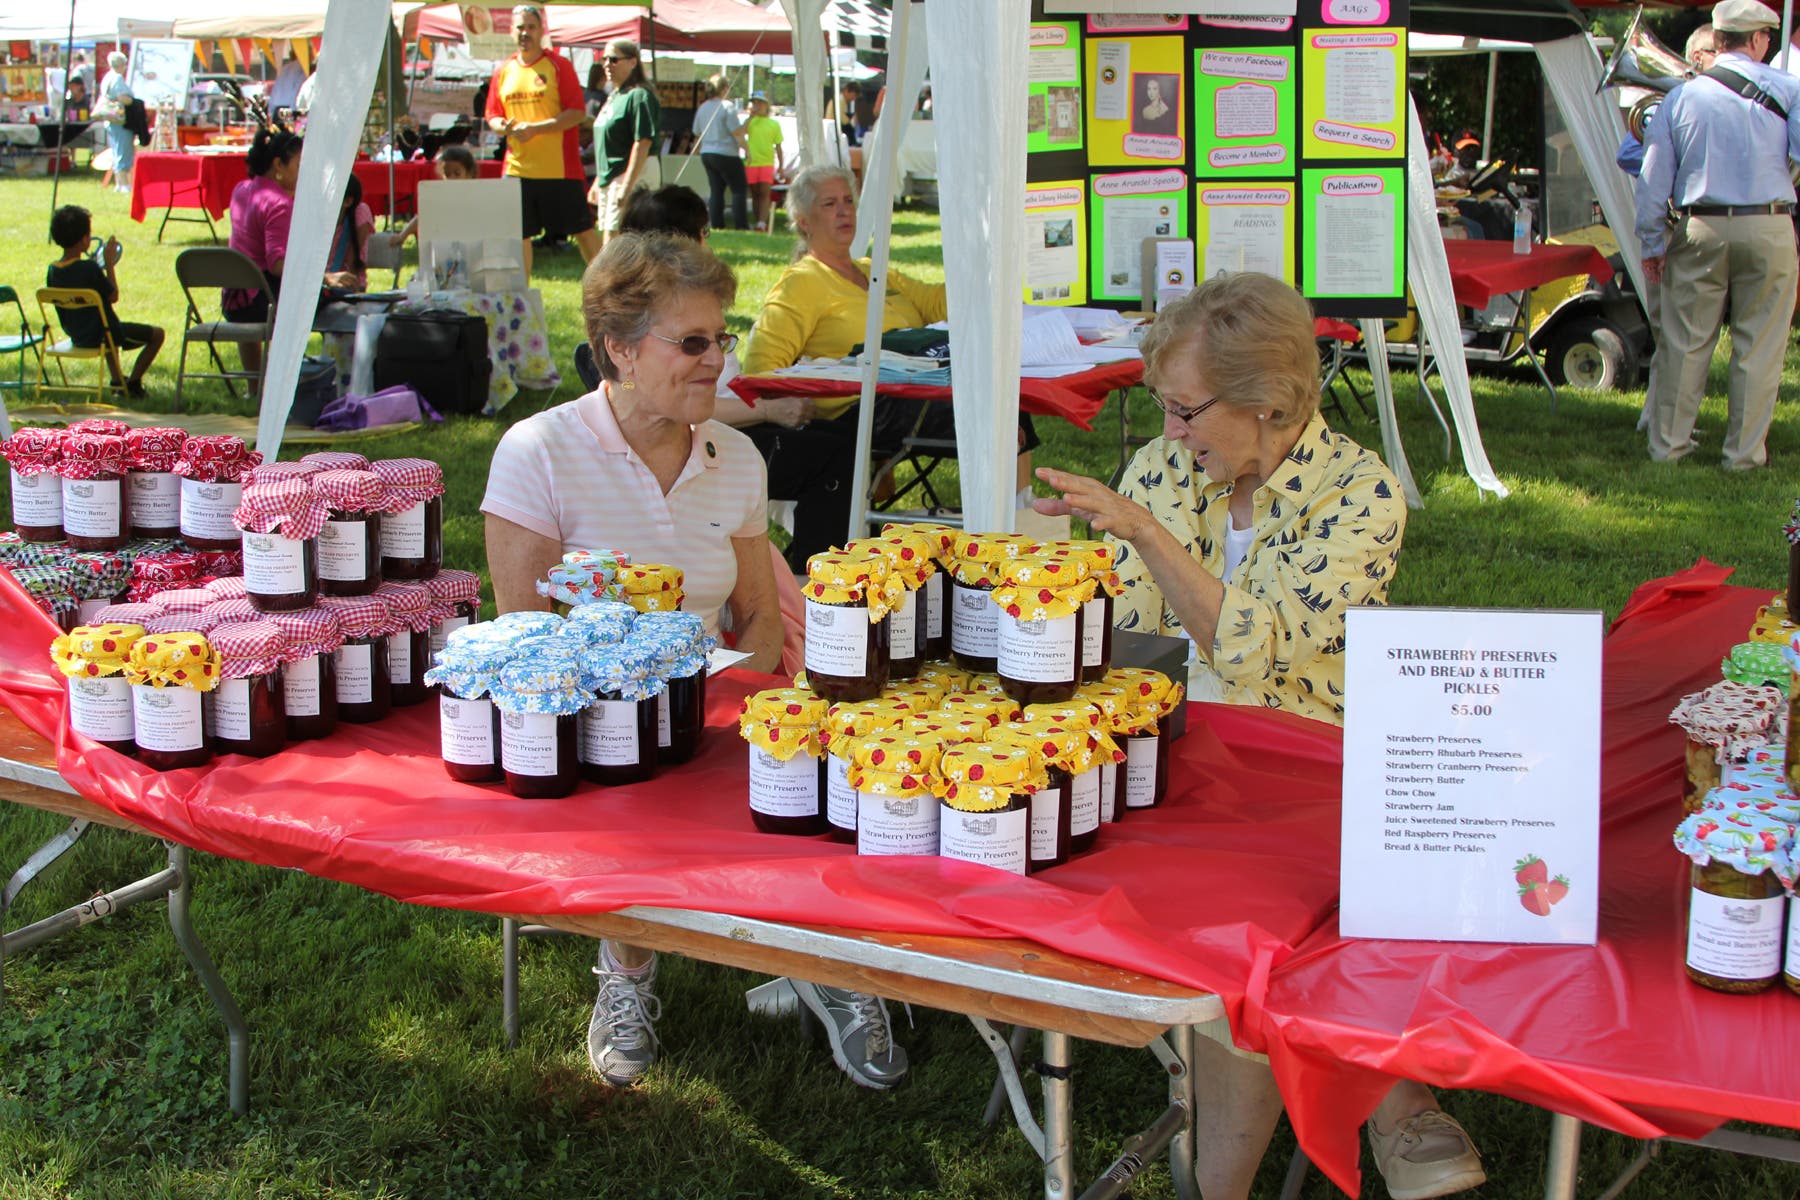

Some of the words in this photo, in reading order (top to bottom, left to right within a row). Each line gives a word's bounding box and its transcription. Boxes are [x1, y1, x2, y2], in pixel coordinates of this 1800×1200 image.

[1339, 4, 1368, 14] AAGS
[1205, 53, 1219, 62] We
[1318, 125, 1351, 137] Request
[1361, 134, 1390, 146] Search
[1214, 152, 1241, 161] Become
[1100, 181, 1119, 189] Anne
[1121, 178, 1150, 188] Arundel
[1152, 175, 1180, 186] Speaks
[1327, 181, 1378, 191] Publications
[1206, 192, 1224, 200] Anne
[1226, 192, 1253, 200] Arundel
[1255, 192, 1286, 201] Readings
[152, 501, 172, 509] Butter
[88, 509, 108, 517] Butter
[975, 626, 999, 634] Preser
[822, 641, 856, 652] Preserves
[1033, 648, 1066, 658] Preserves
[1387, 648, 1476, 661] STRAWBERRY
[1481, 651, 1557, 663] PRESERVES
[1399, 665, 1425, 676] AND
[1431, 666, 1475, 677] BREAD
[1480, 667, 1489, 678] &
[1494, 667, 1545, 679] BUTTER
[1444, 682, 1500, 694] PICKLES
[1451, 704, 1492, 716] $5.00
[456, 733, 487, 741] Preserves
[600, 734, 633, 742] Preserves
[1387, 735, 1434, 744] Strawberry
[1438, 736, 1481, 744] Preserves
[1386, 748, 1434, 757] Strawberry
[1437, 749, 1476, 757] Rhubarb
[1479, 750, 1522, 758] Preserves
[1386, 761, 1434, 770] Strawberry
[1437, 763, 1482, 772] Cranberry
[1485, 764, 1528, 772] Preserves
[1385, 775, 1433, 785] Strawberry
[1437, 776, 1465, 784] Butter
[773, 784, 808, 792] Preserves
[1412, 789, 1435, 797] Chow
[1385, 802, 1433, 811] Strawberry
[1437, 803, 1454, 811] Jam
[1385, 816, 1408, 824] Juice
[1410, 816, 1457, 824] Sweetened
[1459, 817, 1508, 826] Strawberry
[1512, 819, 1555, 827] Preserves
[865, 828, 903, 842] Strawberry
[1385, 829, 1401, 837] Red
[1405, 830, 1449, 839] Raspberry
[1453, 831, 1496, 839] Preserves
[945, 846, 981, 860] Strawberry
[983, 850, 1018, 859] Preserves
[1423, 844, 1451, 852] Butter
[1454, 844, 1485, 852] Pickles
